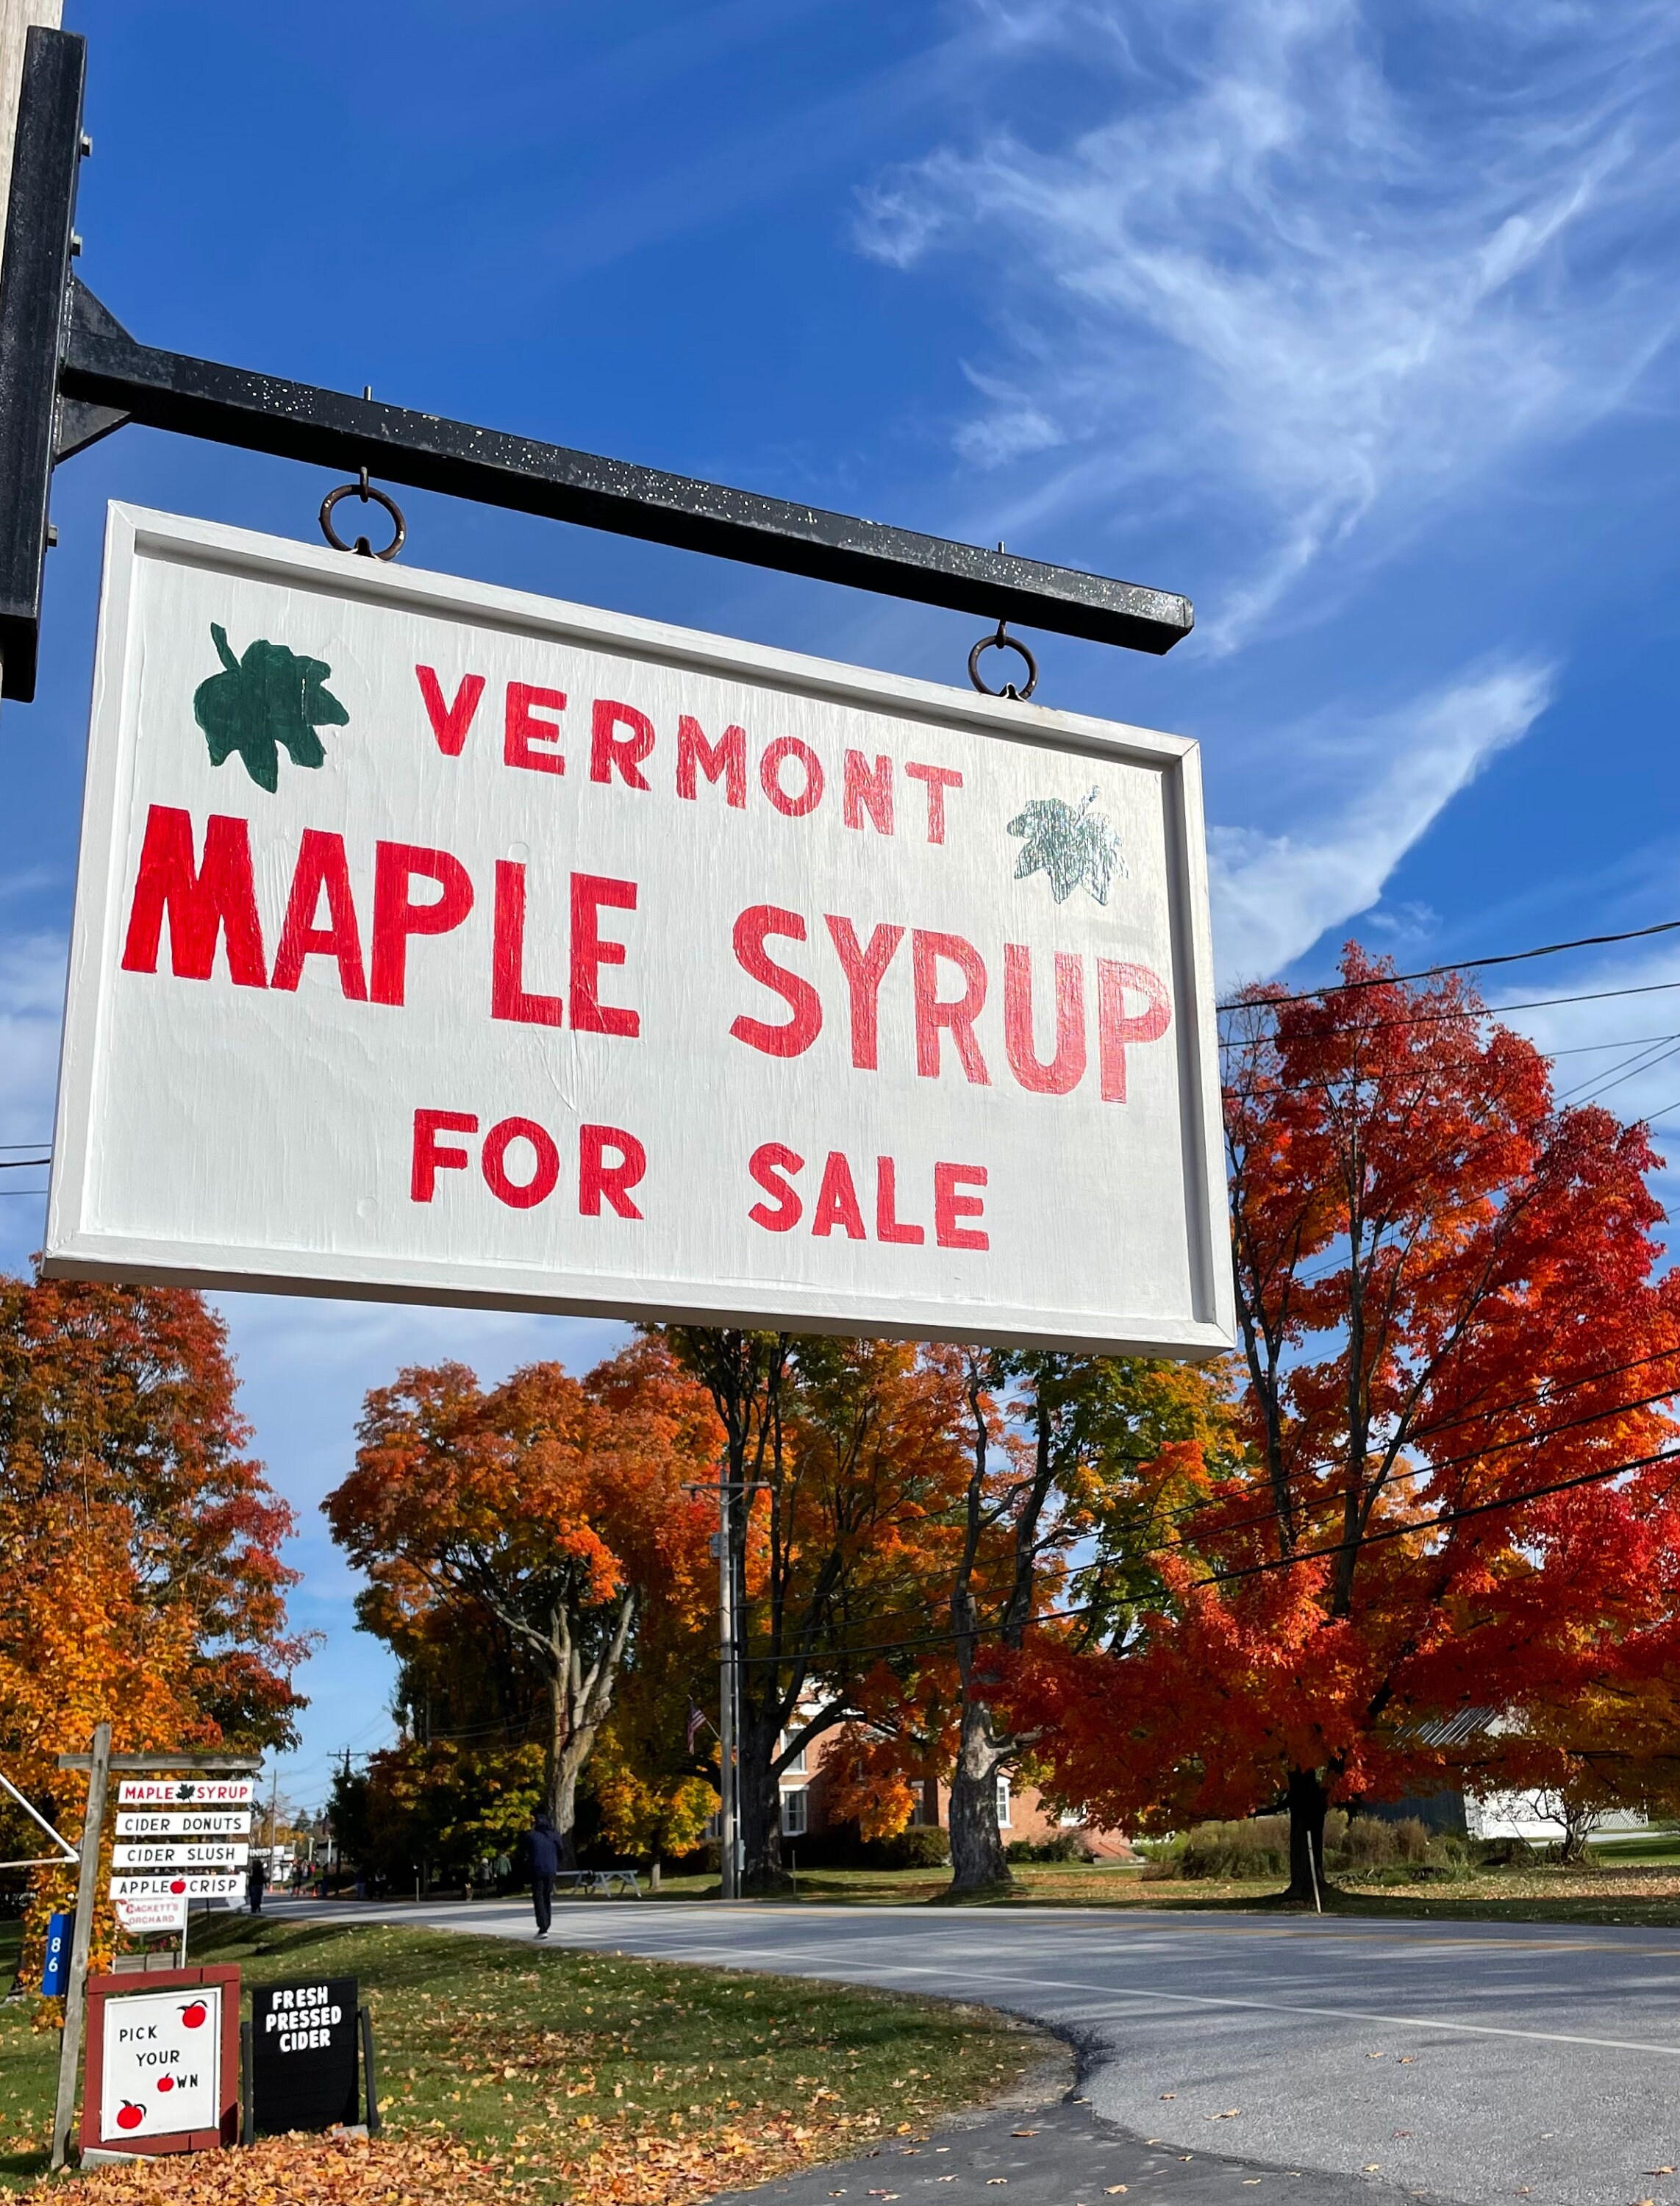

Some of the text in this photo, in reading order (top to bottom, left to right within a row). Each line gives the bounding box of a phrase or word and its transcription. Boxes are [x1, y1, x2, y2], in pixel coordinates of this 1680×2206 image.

[415, 665, 963, 844] VERMONT
[121, 804, 1172, 1103] MAPLE SYRUP
[410, 1108, 990, 1251] FOR SALE
[125, 1786, 248, 1799] MAPLE SYRUP
[125, 1818, 241, 1831] CIDER DONUTS
[127, 1847, 235, 1861] CIDER SLUSH
[249, 1848, 272, 1857] INIS
[119, 1880, 237, 1893] APPLE CRISP
[129, 1915, 175, 1924] ORCHARD
[272, 1985, 328, 2010] FRESH
[265, 2005, 342, 2032] PRESSED
[120, 2025, 157, 2042] PICK
[279, 2028, 331, 2052] CIDER
[136, 2050, 180, 2066] YOUR
